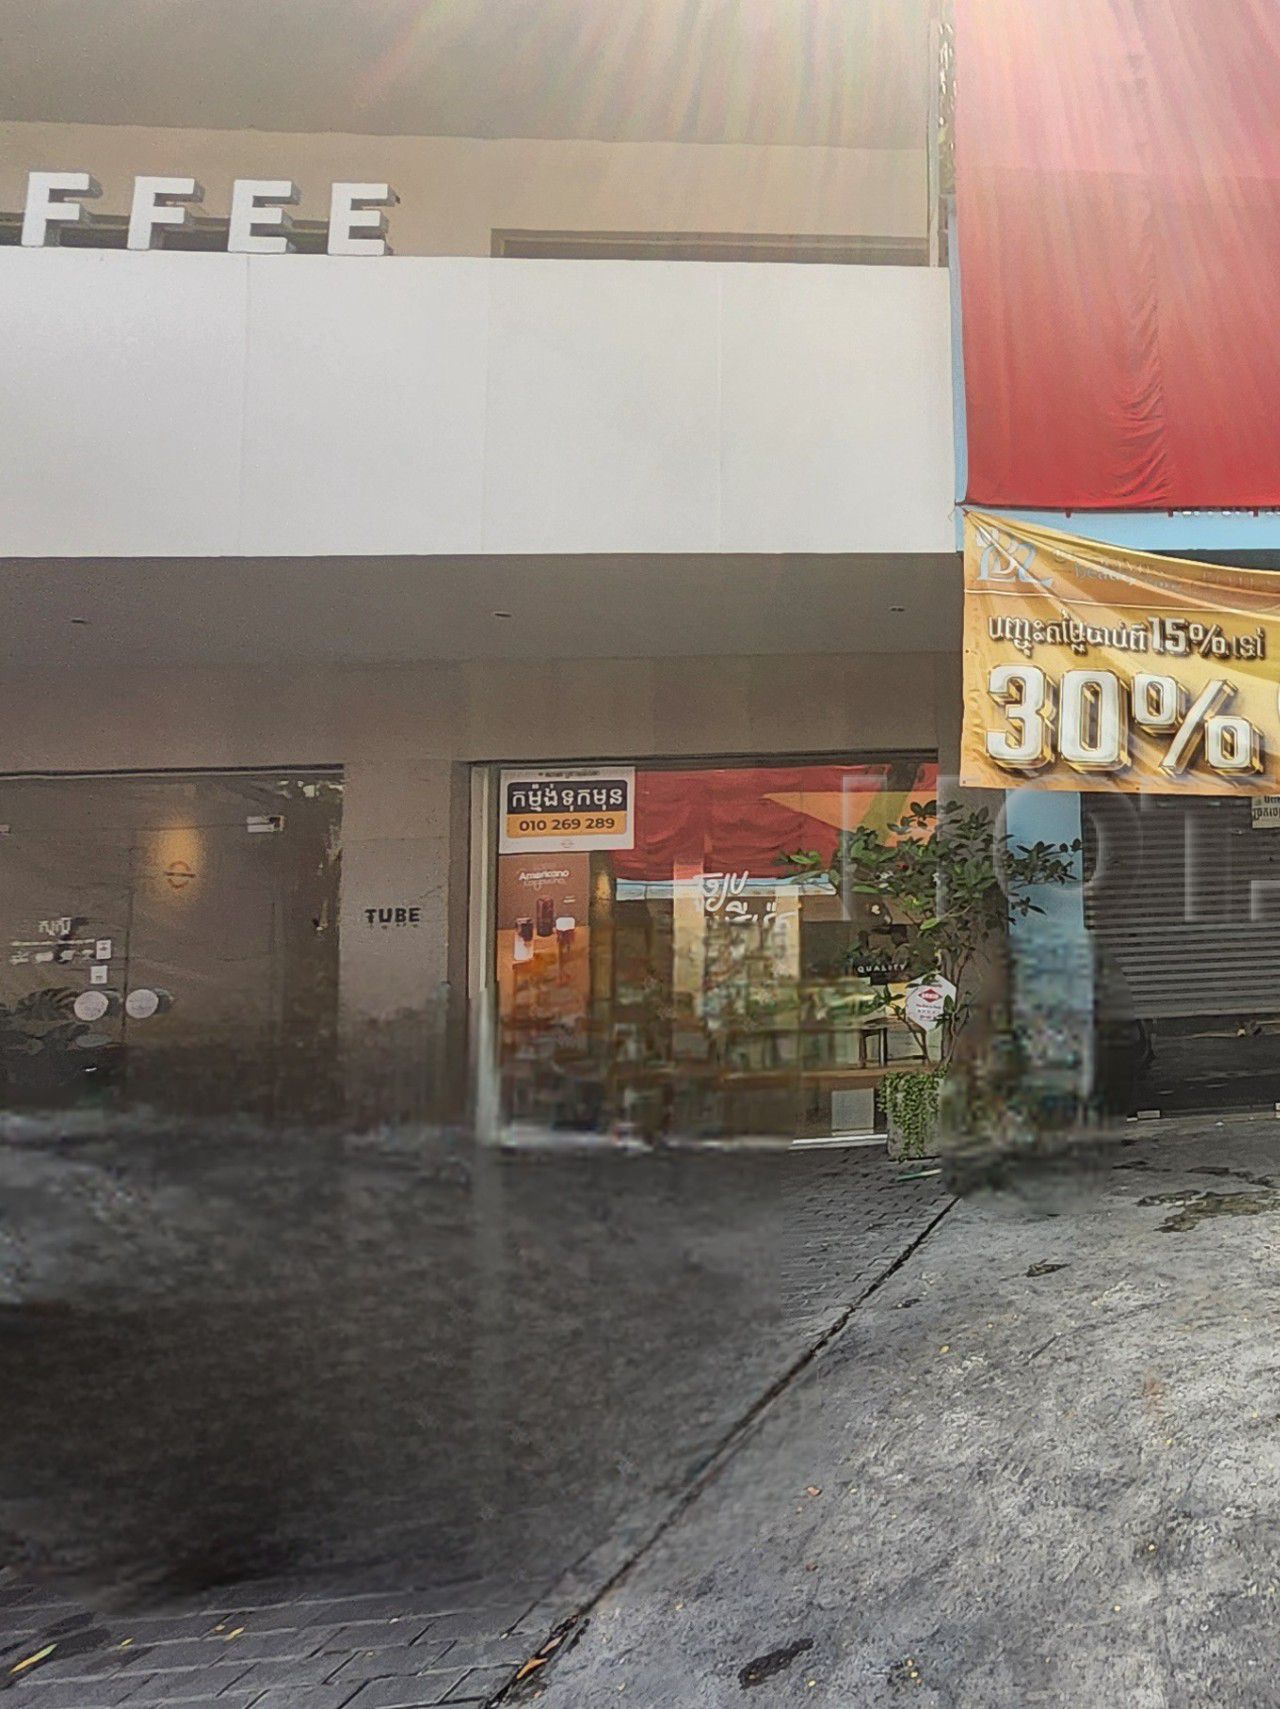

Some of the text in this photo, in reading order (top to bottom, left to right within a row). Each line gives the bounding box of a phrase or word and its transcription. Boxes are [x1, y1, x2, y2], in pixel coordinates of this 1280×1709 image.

[985, 664, 1264, 776] 30%
[519, 817, 615, 831] 010 269 289
[364, 908, 421, 923] TUBE
[857, 962, 907, 974] QUALITY
